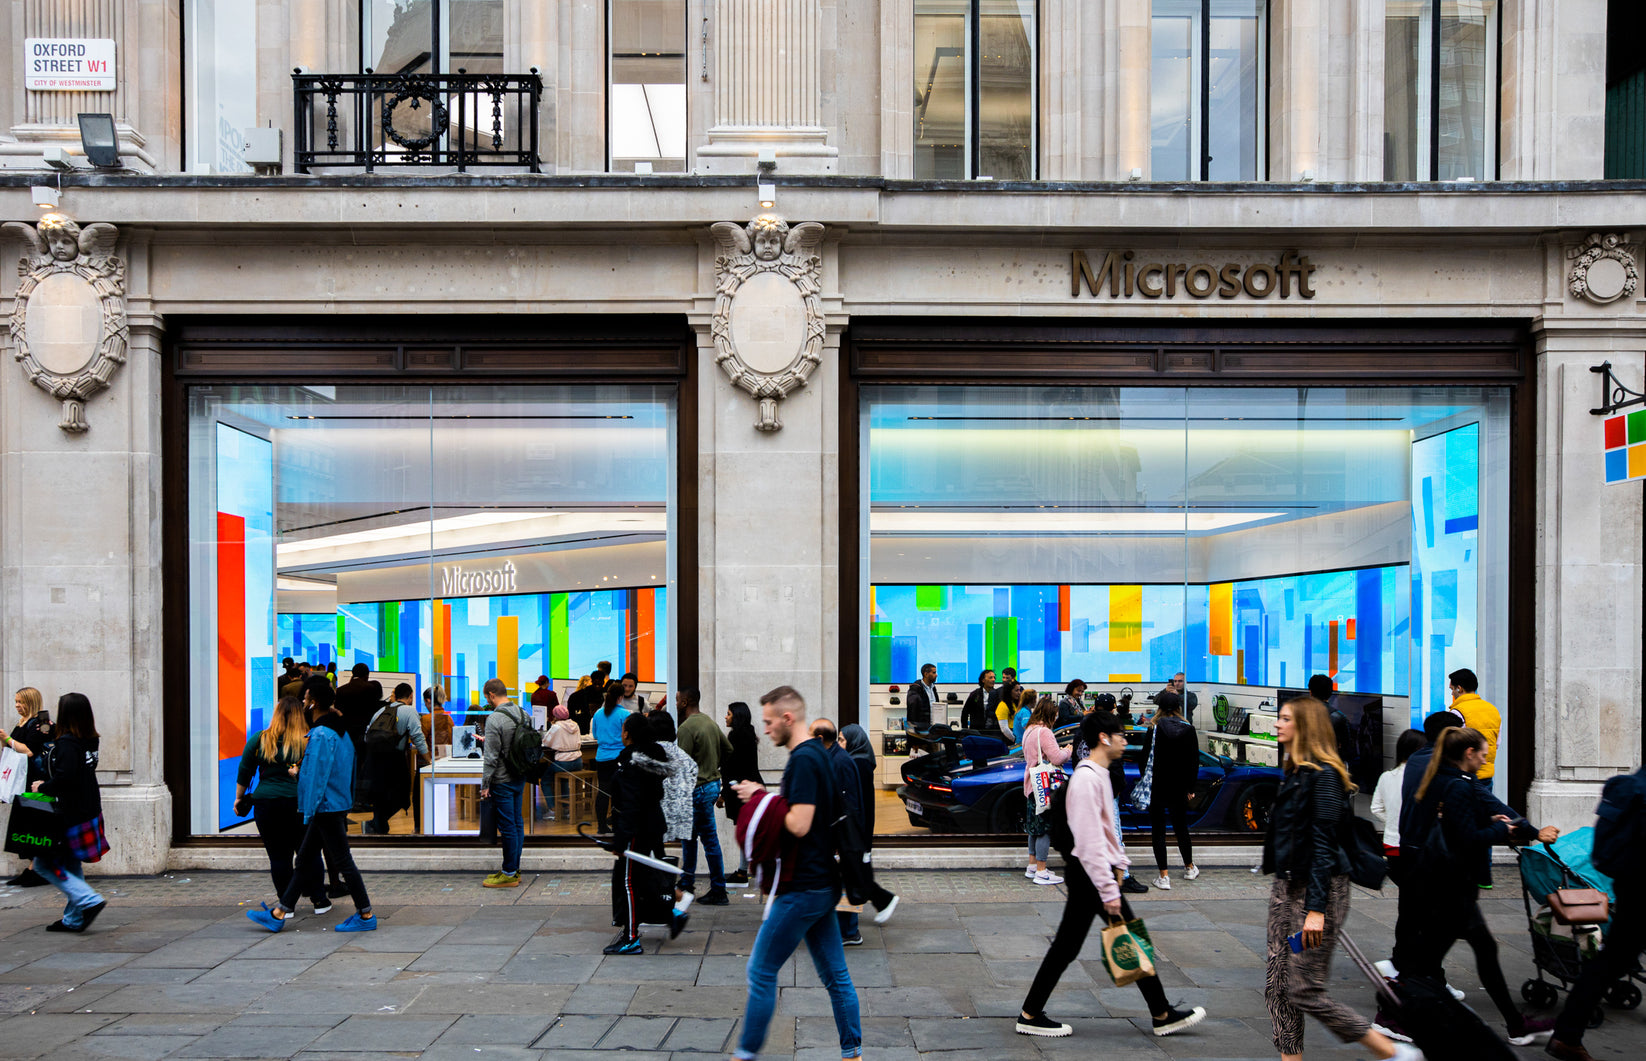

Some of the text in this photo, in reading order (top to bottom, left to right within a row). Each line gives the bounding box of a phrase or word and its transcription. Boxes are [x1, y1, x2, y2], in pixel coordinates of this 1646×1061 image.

[33, 43, 86, 57] OXFORD
[33, 59, 107, 73] STREET W1
[34, 79, 102, 87] CITY OF WESTMINSTER
[1071, 249, 1316, 299] Microsoft
[441, 559, 517, 596] Microsoft
[1035, 772, 1047, 808] LONDON
[11, 832, 53, 848] schuh
